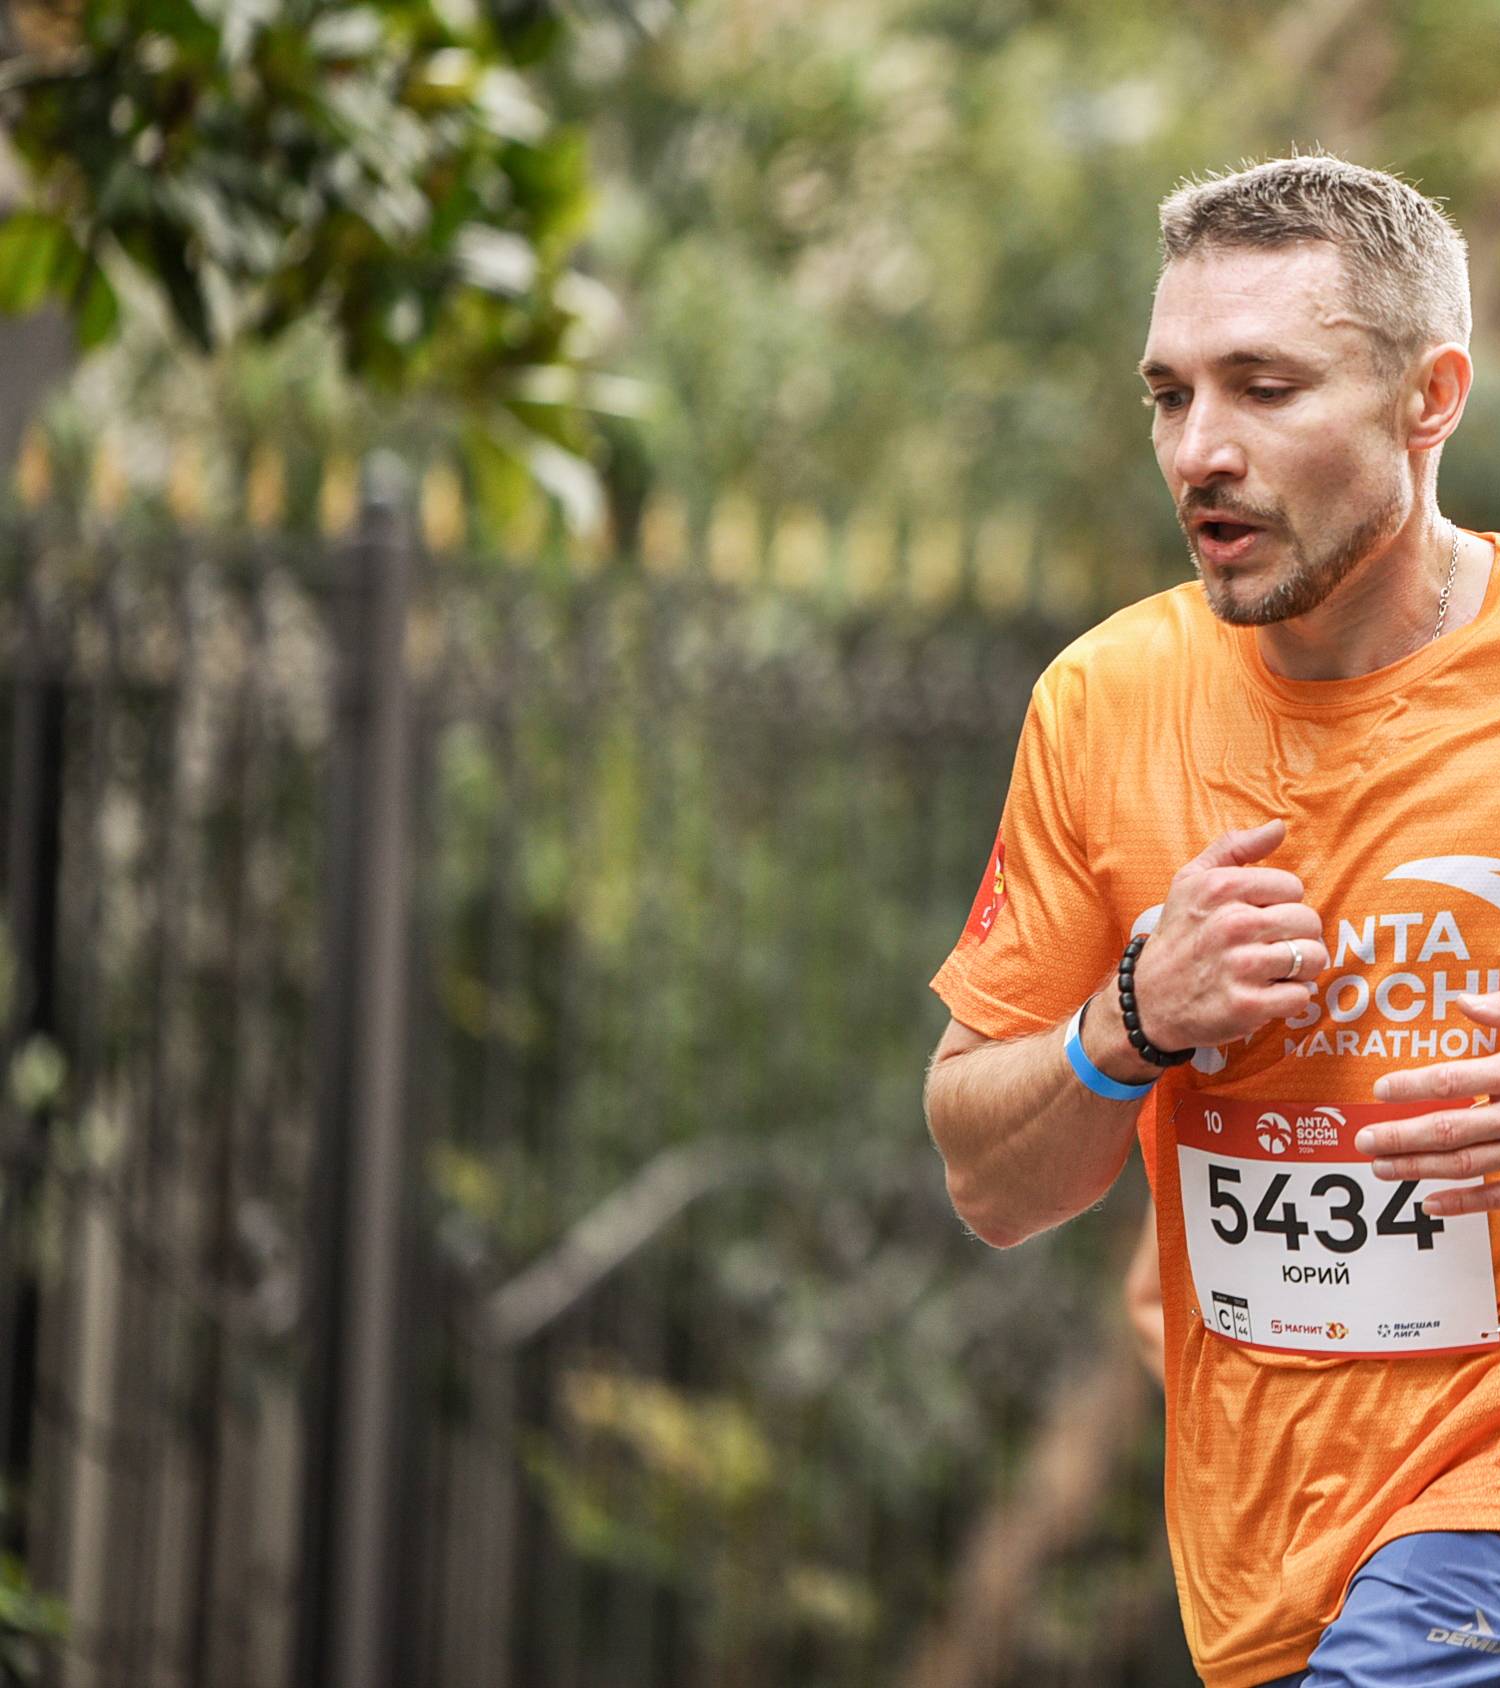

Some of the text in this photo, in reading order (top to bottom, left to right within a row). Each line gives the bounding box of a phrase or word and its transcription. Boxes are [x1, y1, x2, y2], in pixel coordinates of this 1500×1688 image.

[1319, 911, 1471, 970] NTA
[1284, 1028, 1497, 1058] MARATHON
[1204, 1109, 1223, 1134] 10
[1296, 1116, 1331, 1128] ANTA
[1296, 1128, 1338, 1139] SOCHI
[1208, 1164, 1445, 1254] 5434
[1282, 1262, 1350, 1285] ЮРИЙ
[1285, 1323, 1323, 1335] МАГНИТ
[1393, 1329, 1420, 1338] ЛИГА
[1394, 1320, 1440, 1330] ВЫСШАЯ
